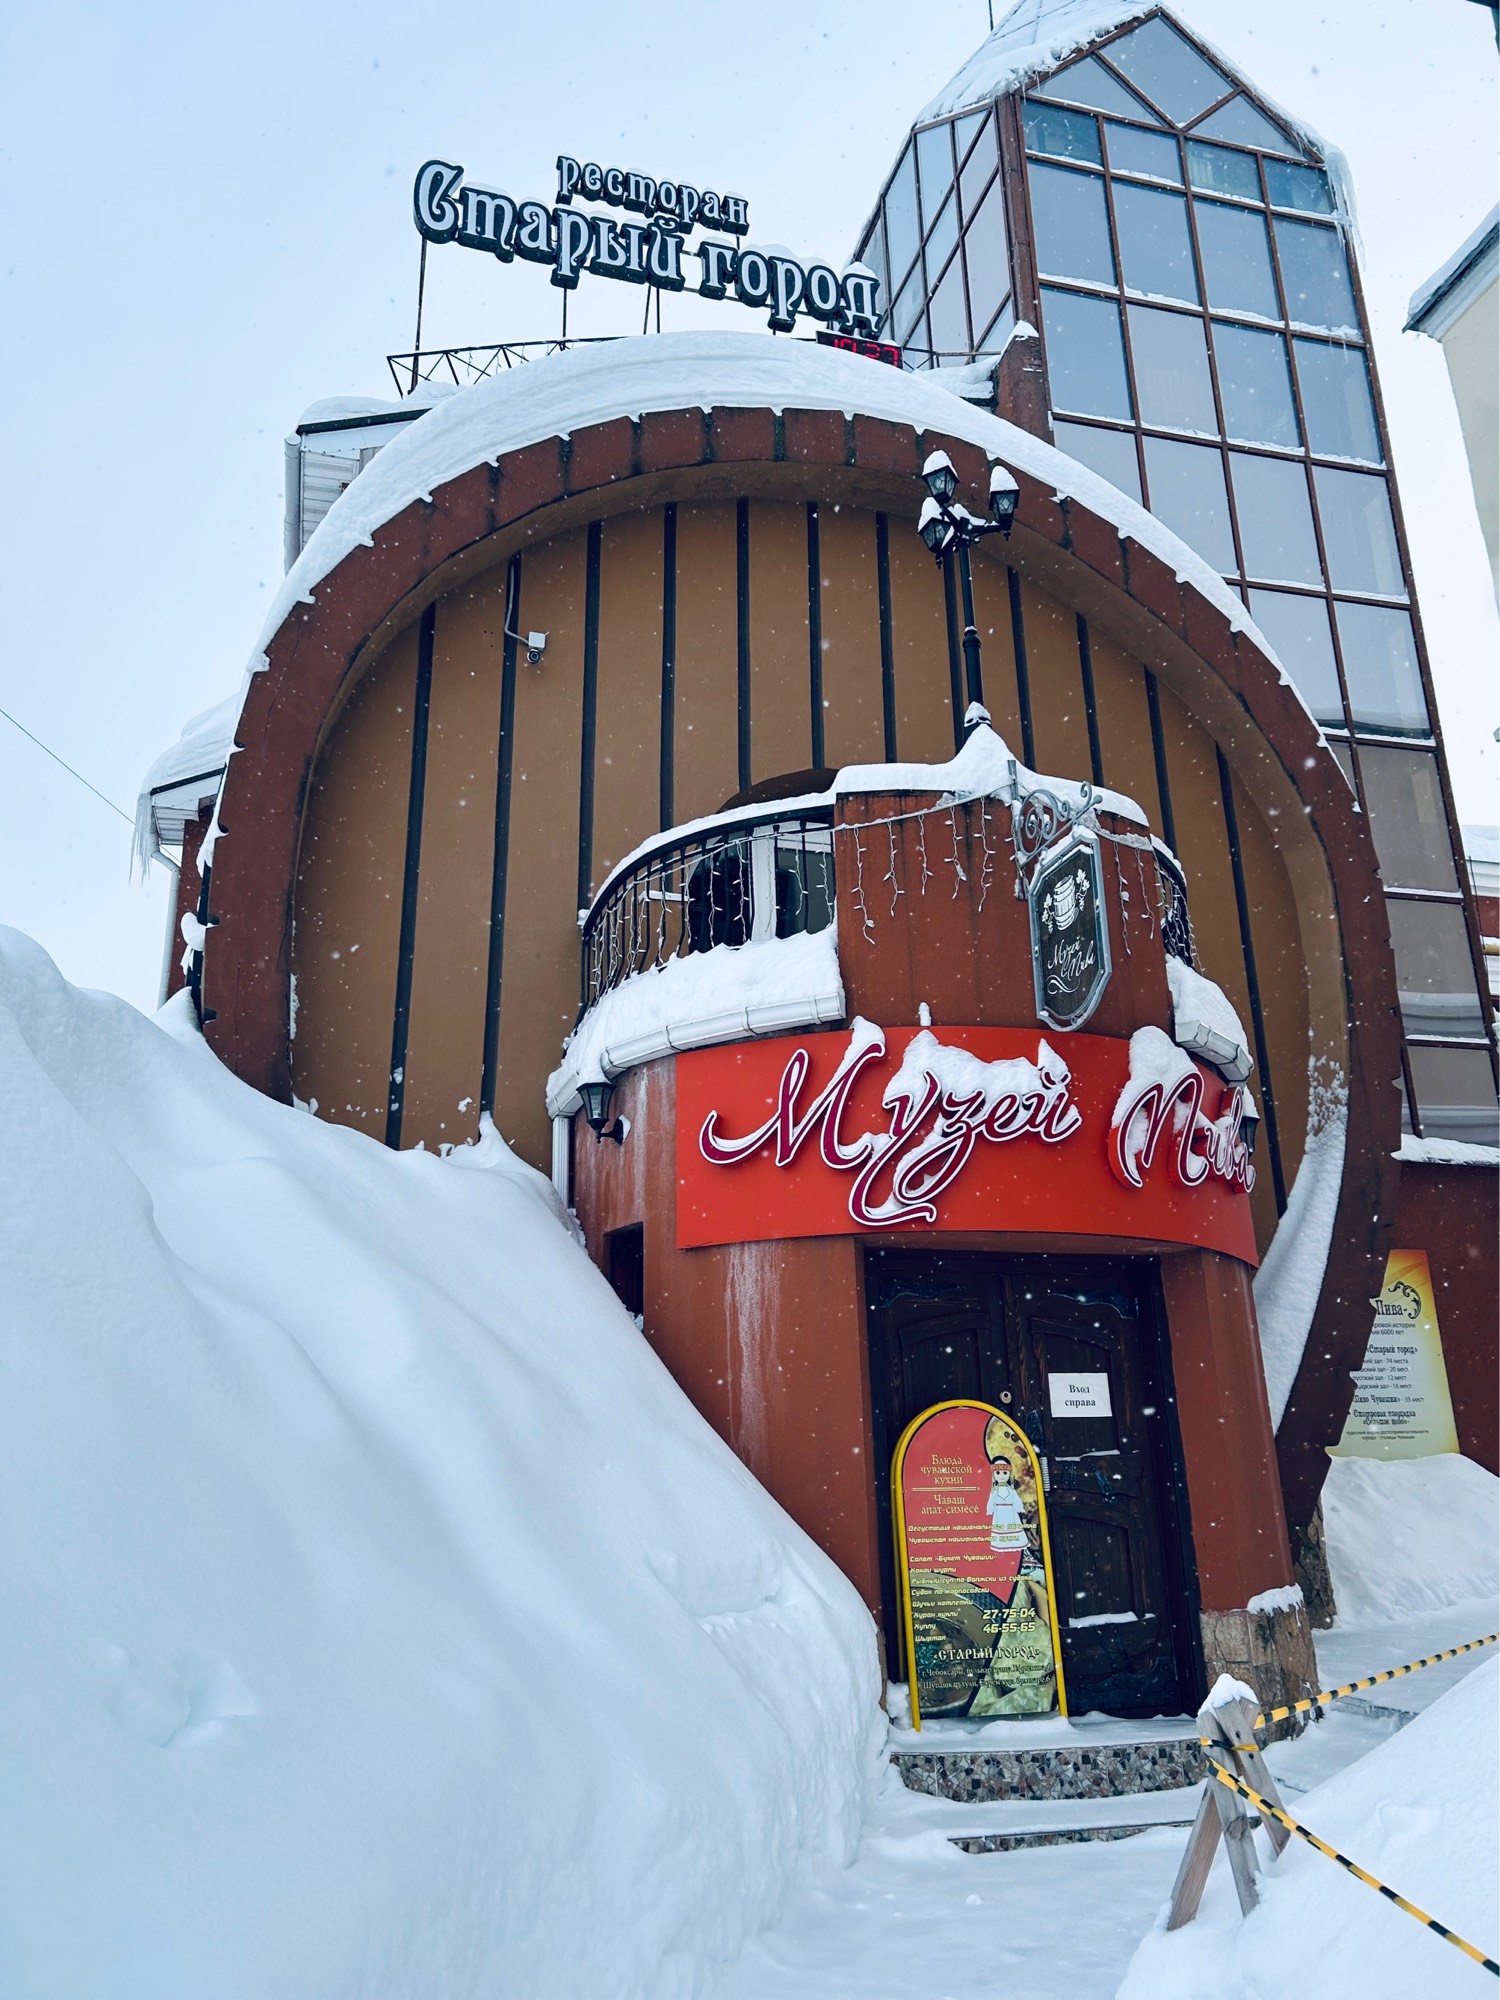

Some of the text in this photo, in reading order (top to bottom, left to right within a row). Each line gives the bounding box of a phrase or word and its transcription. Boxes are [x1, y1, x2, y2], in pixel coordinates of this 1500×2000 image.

[556, 155, 749, 233] ресторан
[414, 160, 882, 334] Старый город
[699, 1041, 1256, 1226] Музей Пива
[1068, 1384, 1091, 1394] Вход
[1064, 1399, 1096, 1409] справа
[931, 1454, 963, 1466] Блюда
[920, 1464, 973, 1477] чувашской
[934, 1476, 963, 1487] кухни
[982, 1607, 1036, 1620] 27-75-04
[982, 1621, 1036, 1634] 46-55-65
